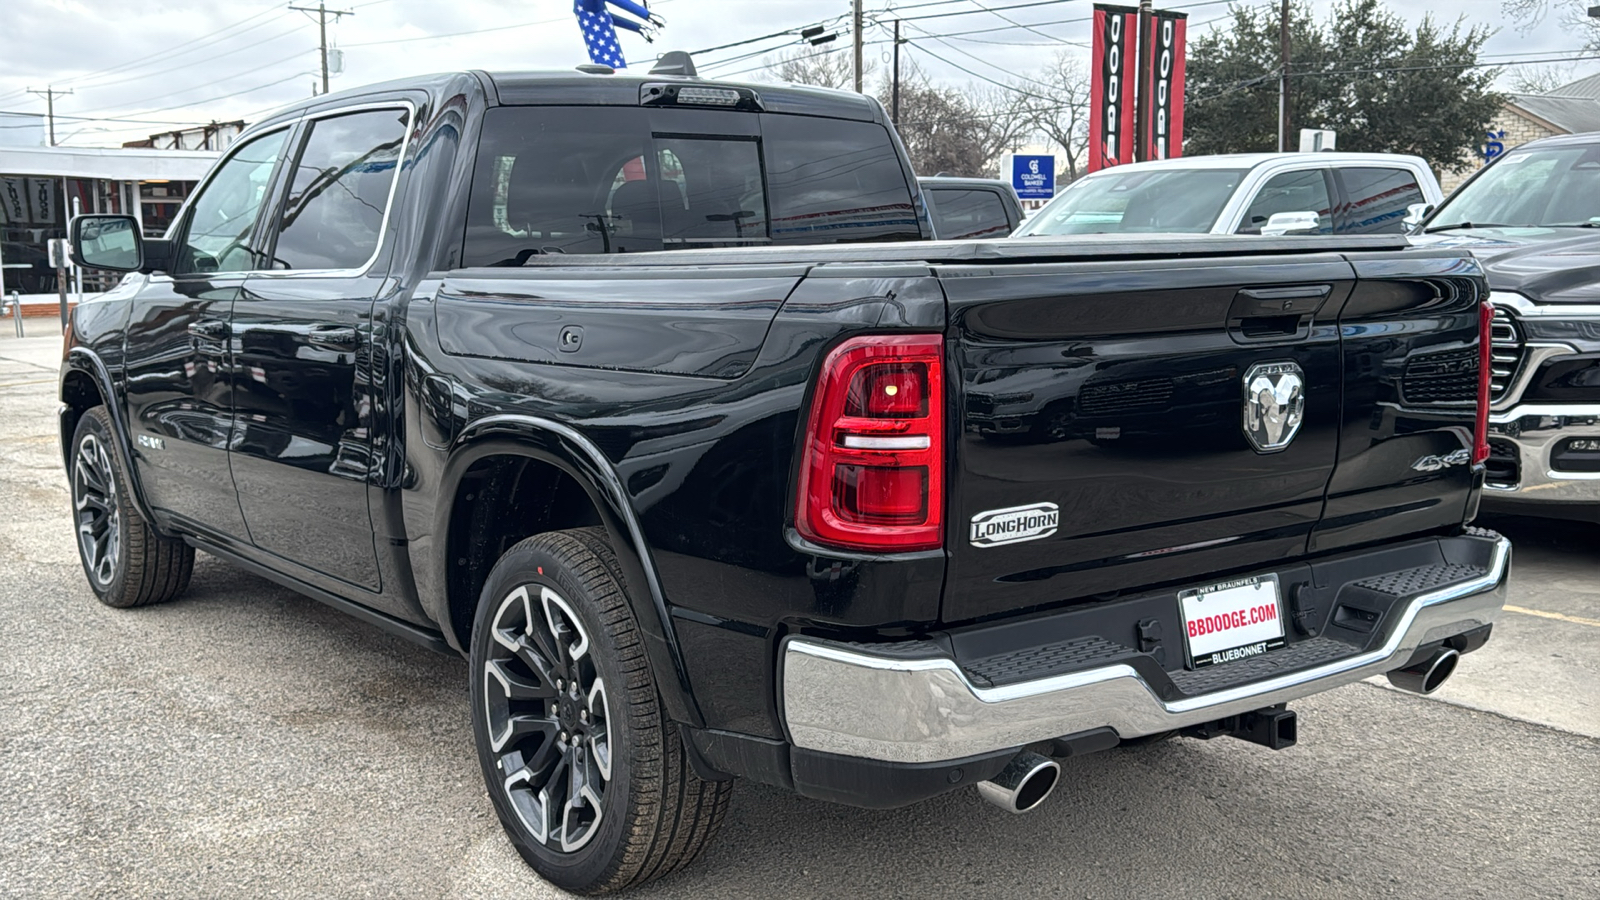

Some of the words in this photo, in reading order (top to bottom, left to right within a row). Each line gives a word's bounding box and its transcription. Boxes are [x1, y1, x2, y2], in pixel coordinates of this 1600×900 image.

[1107, 14, 1121, 160] DODGE
[1157, 20, 1172, 160] DODGE
[1260, 365, 1295, 374] RAM
[973, 513, 1058, 540] LONGHORN
[1200, 586, 1215, 594] NEW
[1217, 577, 1258, 591] BRAUNFELS
[1188, 603, 1277, 638] BBDODGE.COM
[1212, 642, 1268, 664] BLUEBONNET
